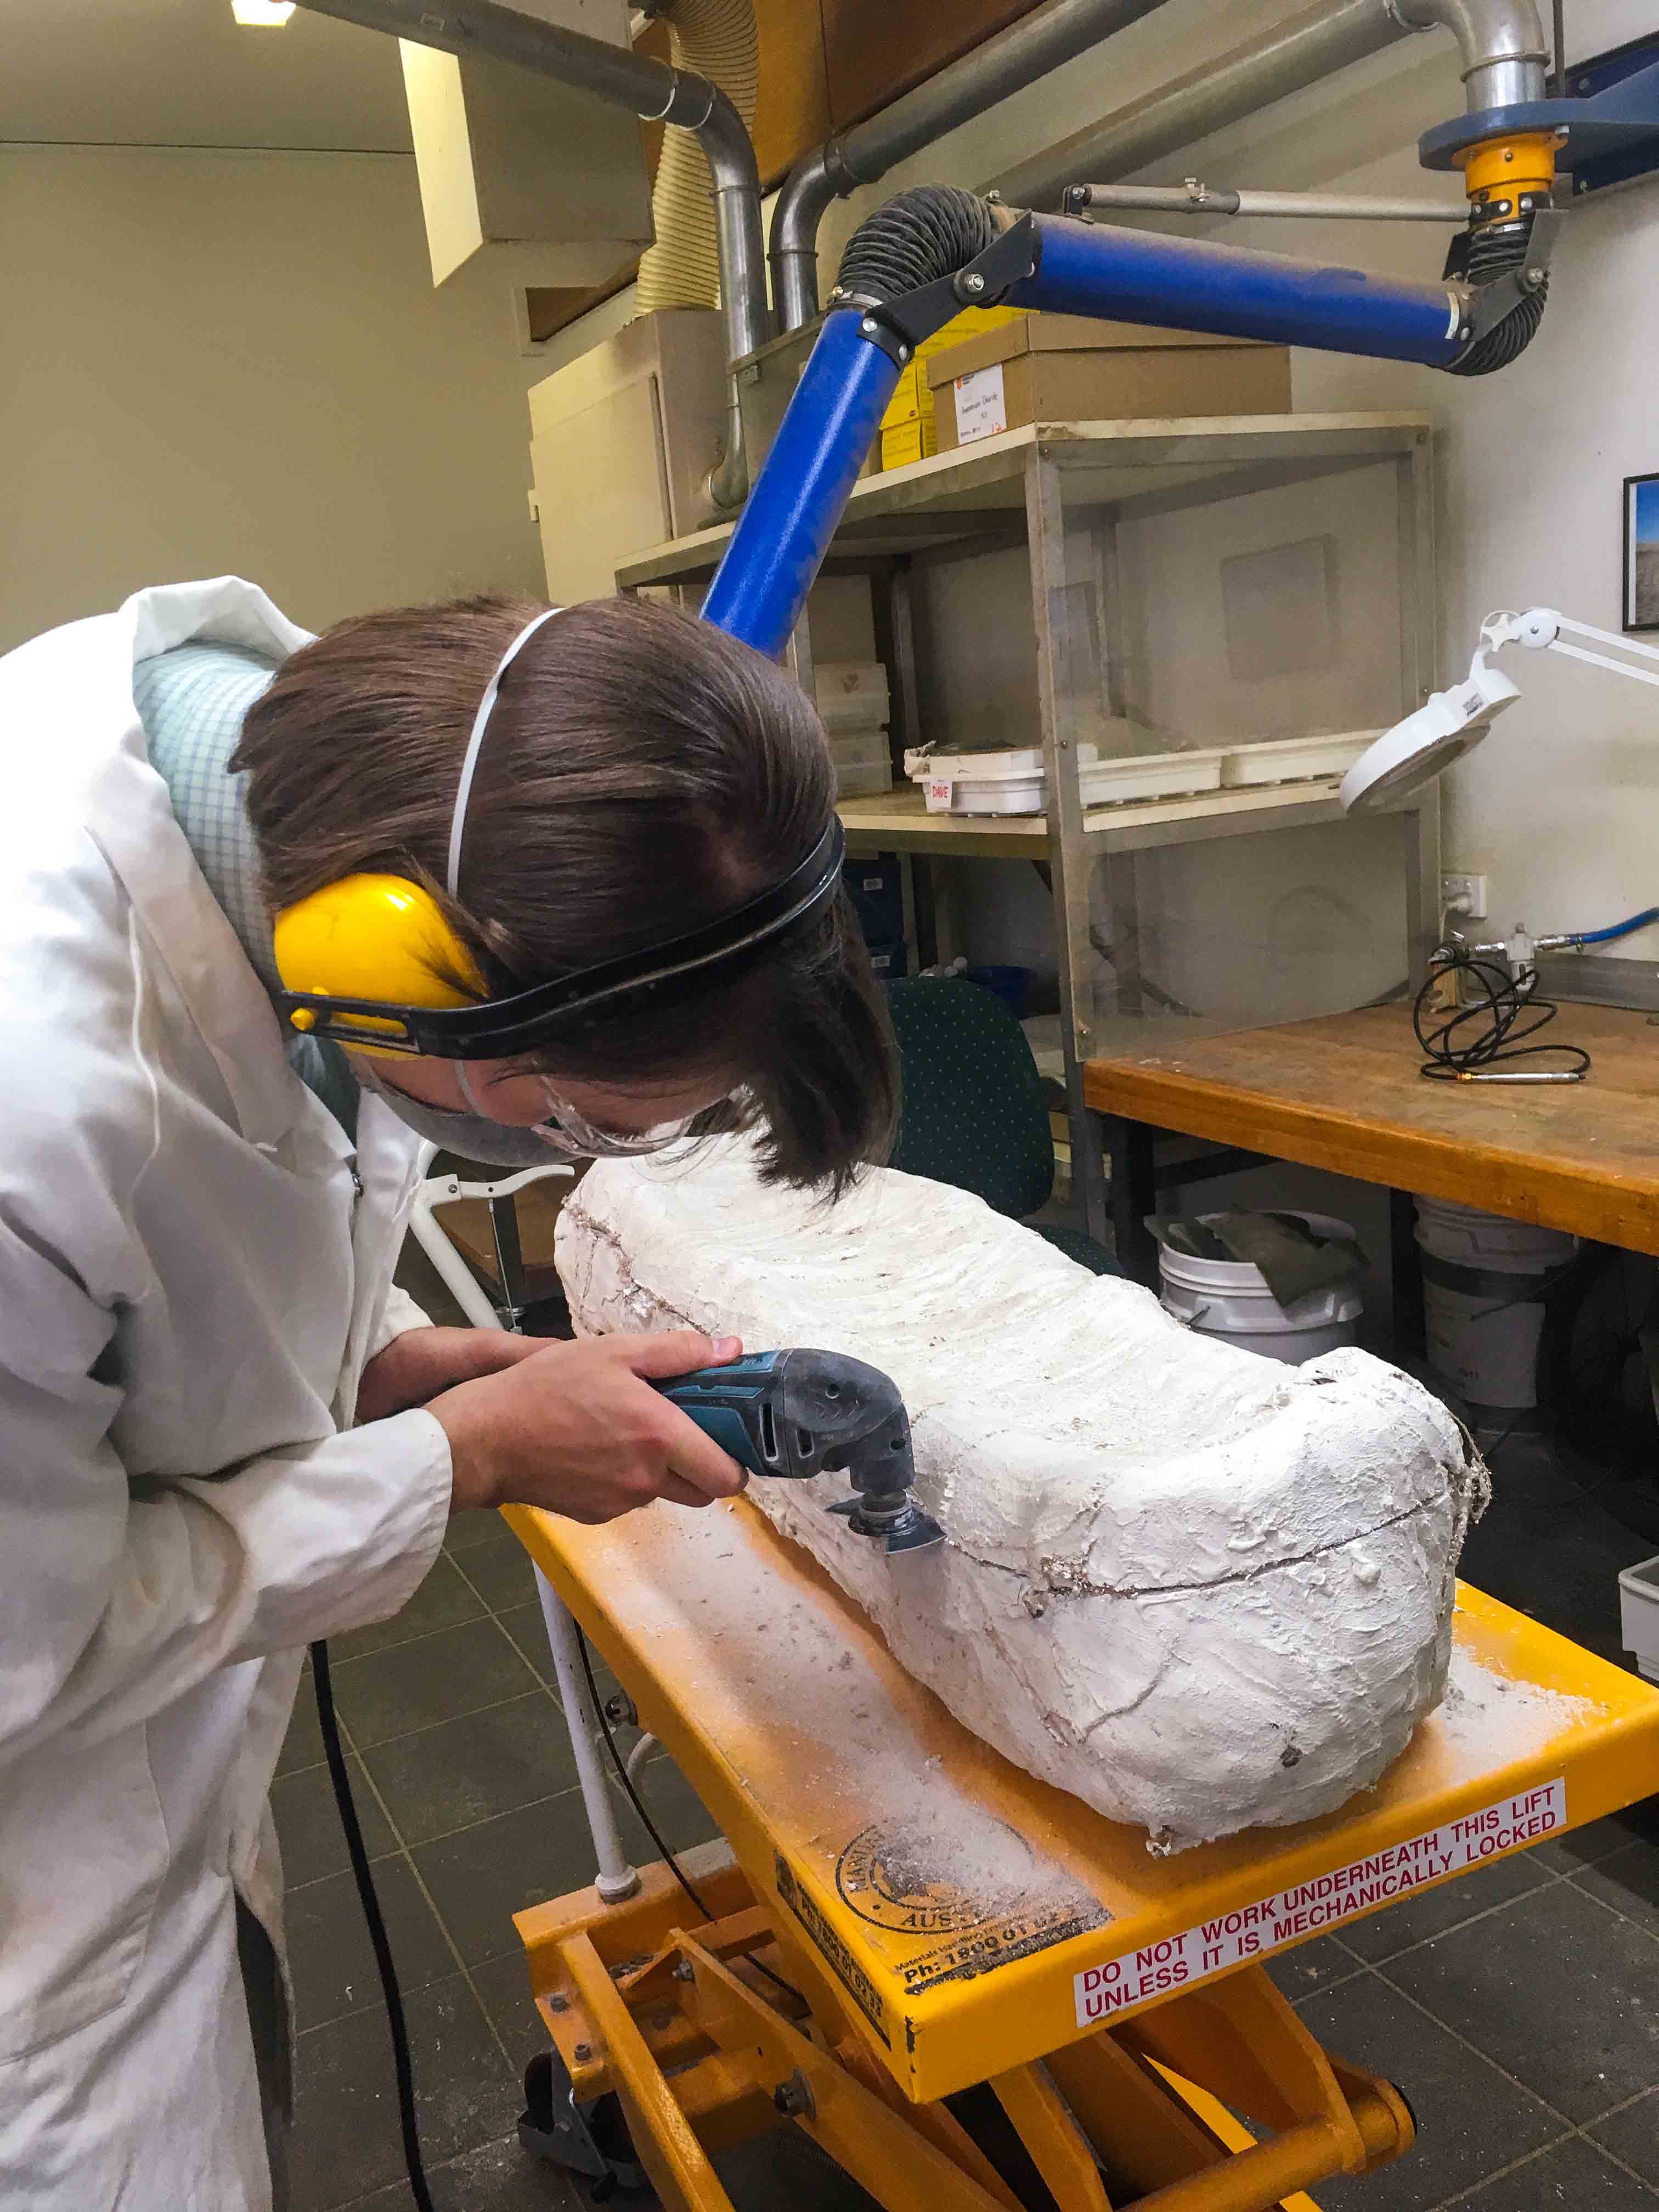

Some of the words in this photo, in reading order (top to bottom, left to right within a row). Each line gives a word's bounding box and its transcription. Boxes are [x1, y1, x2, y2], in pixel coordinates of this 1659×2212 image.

[904, 1962, 941, 1983] Ph:
[1084, 1960, 1121, 1992] DO
[1135, 1933, 1187, 1972] NOT
[1201, 1899, 1277, 1941] WORK
[1284, 1833, 1438, 1911] UNDERNEATH
[1450, 1809, 1499, 1841] THIS
[1511, 1786, 1555, 1819] LIFT
[1085, 1961, 1189, 2017] UNLESS
[1203, 1944, 1223, 1970] IT
[1238, 1931, 1260, 1956] IS
[1273, 1851, 1453, 1940] MECHANICALLY
[1466, 1811, 1556, 1862] LOCKED
